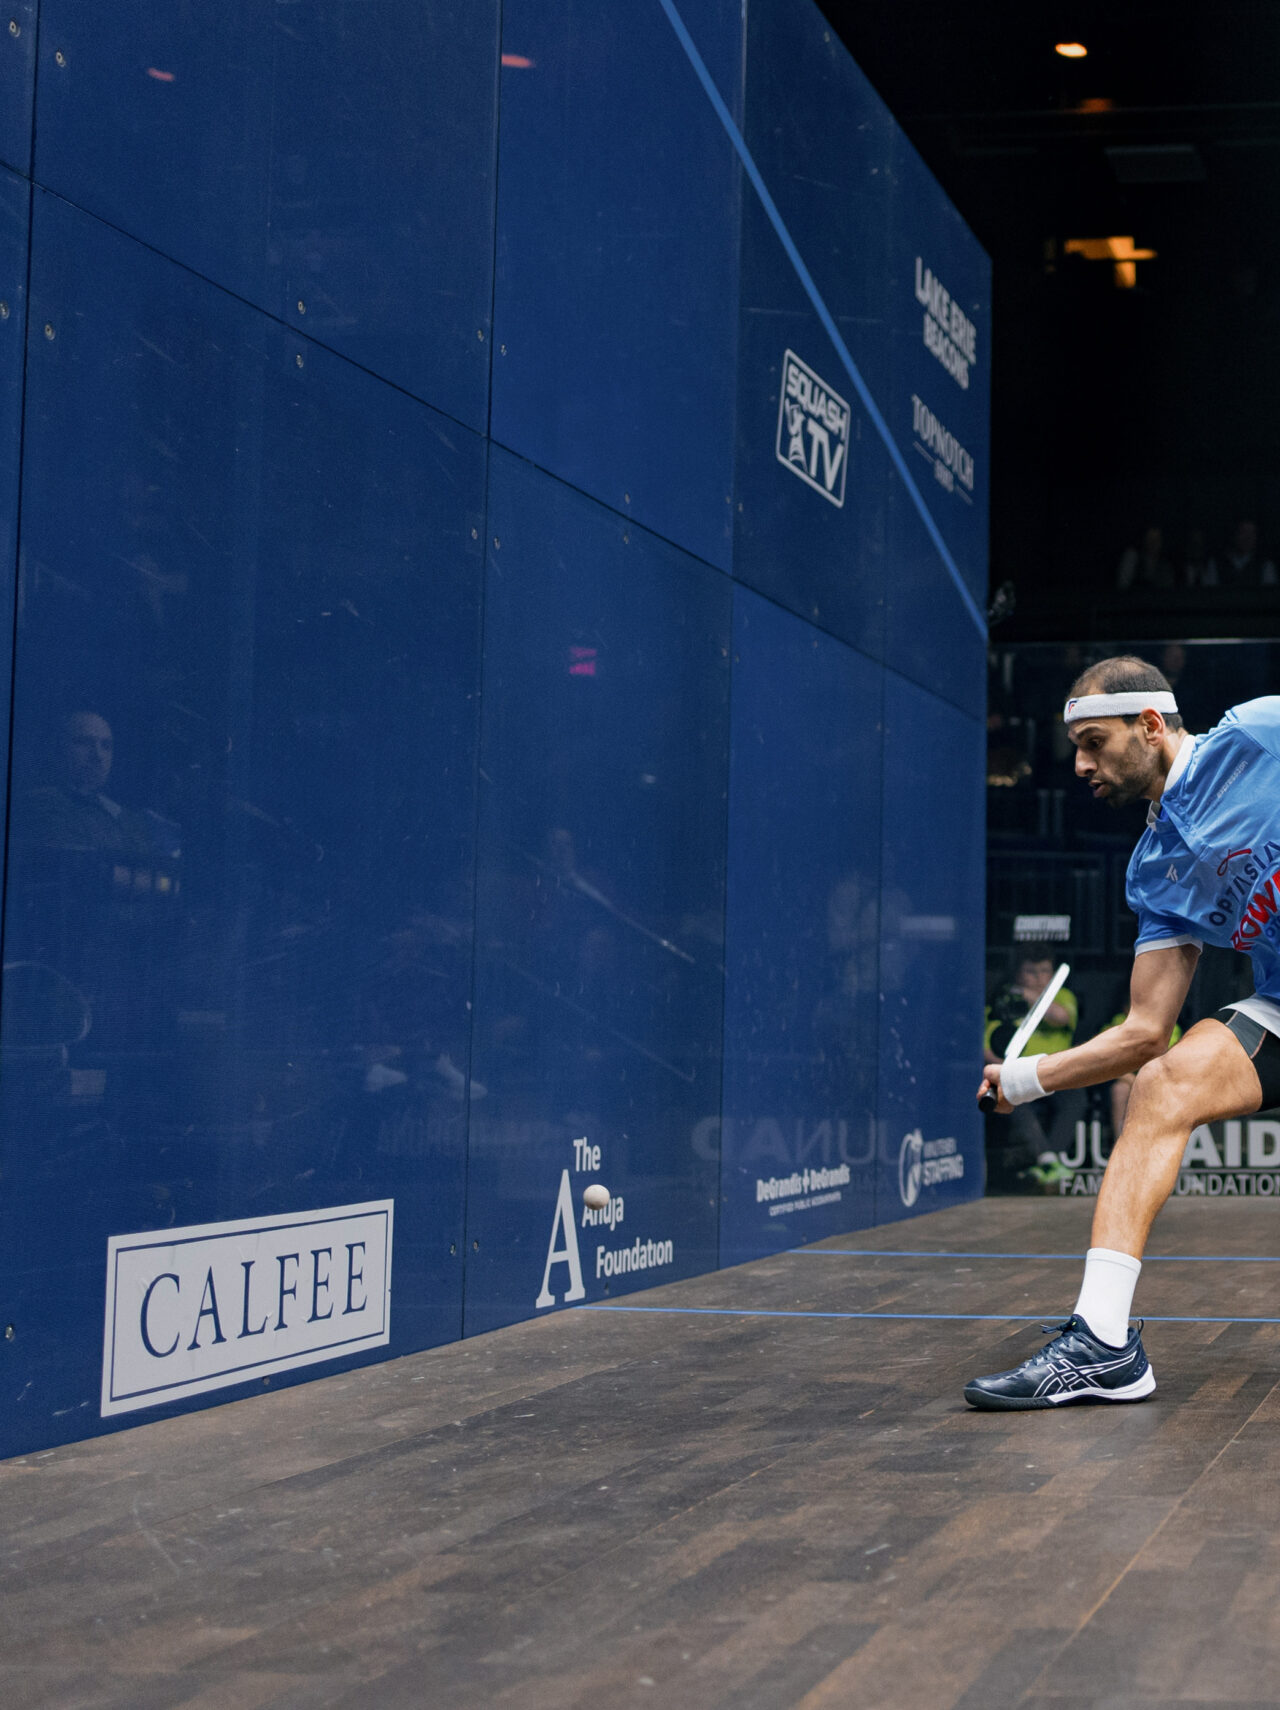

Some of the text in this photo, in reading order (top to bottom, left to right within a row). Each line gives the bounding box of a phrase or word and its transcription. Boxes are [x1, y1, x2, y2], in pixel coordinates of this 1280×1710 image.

[787, 363, 847, 441] SQUASH
[807, 417, 844, 485] TV
[911, 393, 974, 491] TOPNOTCH
[573, 1136, 601, 1172] The
[757, 1173, 802, 1203] DeGrandis
[811, 1163, 850, 1192] DeGrandis
[596, 1236, 673, 1279] Foundation
[140, 1241, 367, 1358] CALFEE
